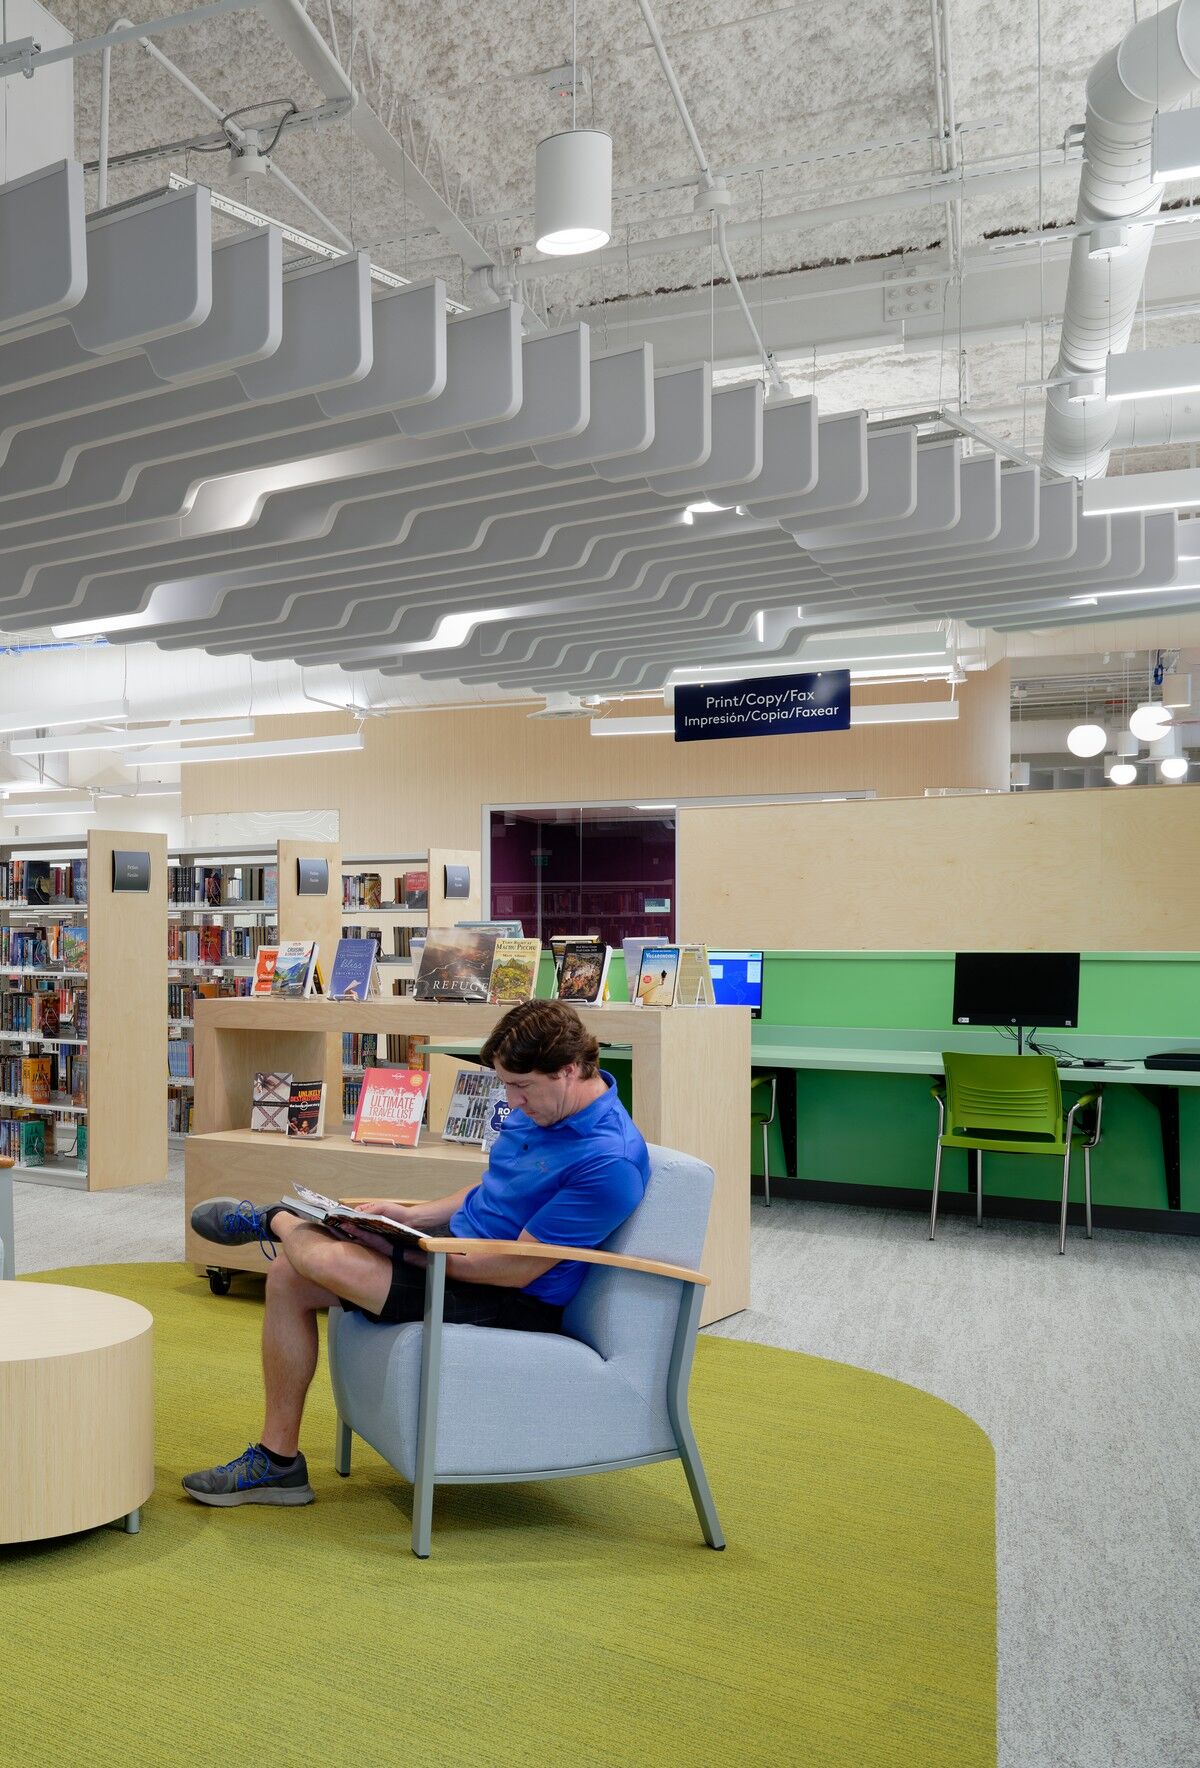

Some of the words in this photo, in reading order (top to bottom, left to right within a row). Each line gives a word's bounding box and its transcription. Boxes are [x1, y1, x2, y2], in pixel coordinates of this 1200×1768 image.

[706, 689, 815, 709] Print/Copy/Fax
[684, 706, 840, 728] Impresión/Copia/Faxear
[433, 980, 489, 991] REFUGE
[370, 1094, 416, 1110] ULTIMATE
[369, 1107, 396, 1118] TRAVEL
[396, 1109, 414, 1120] LIST
[497, 1107, 513, 1115] RO
